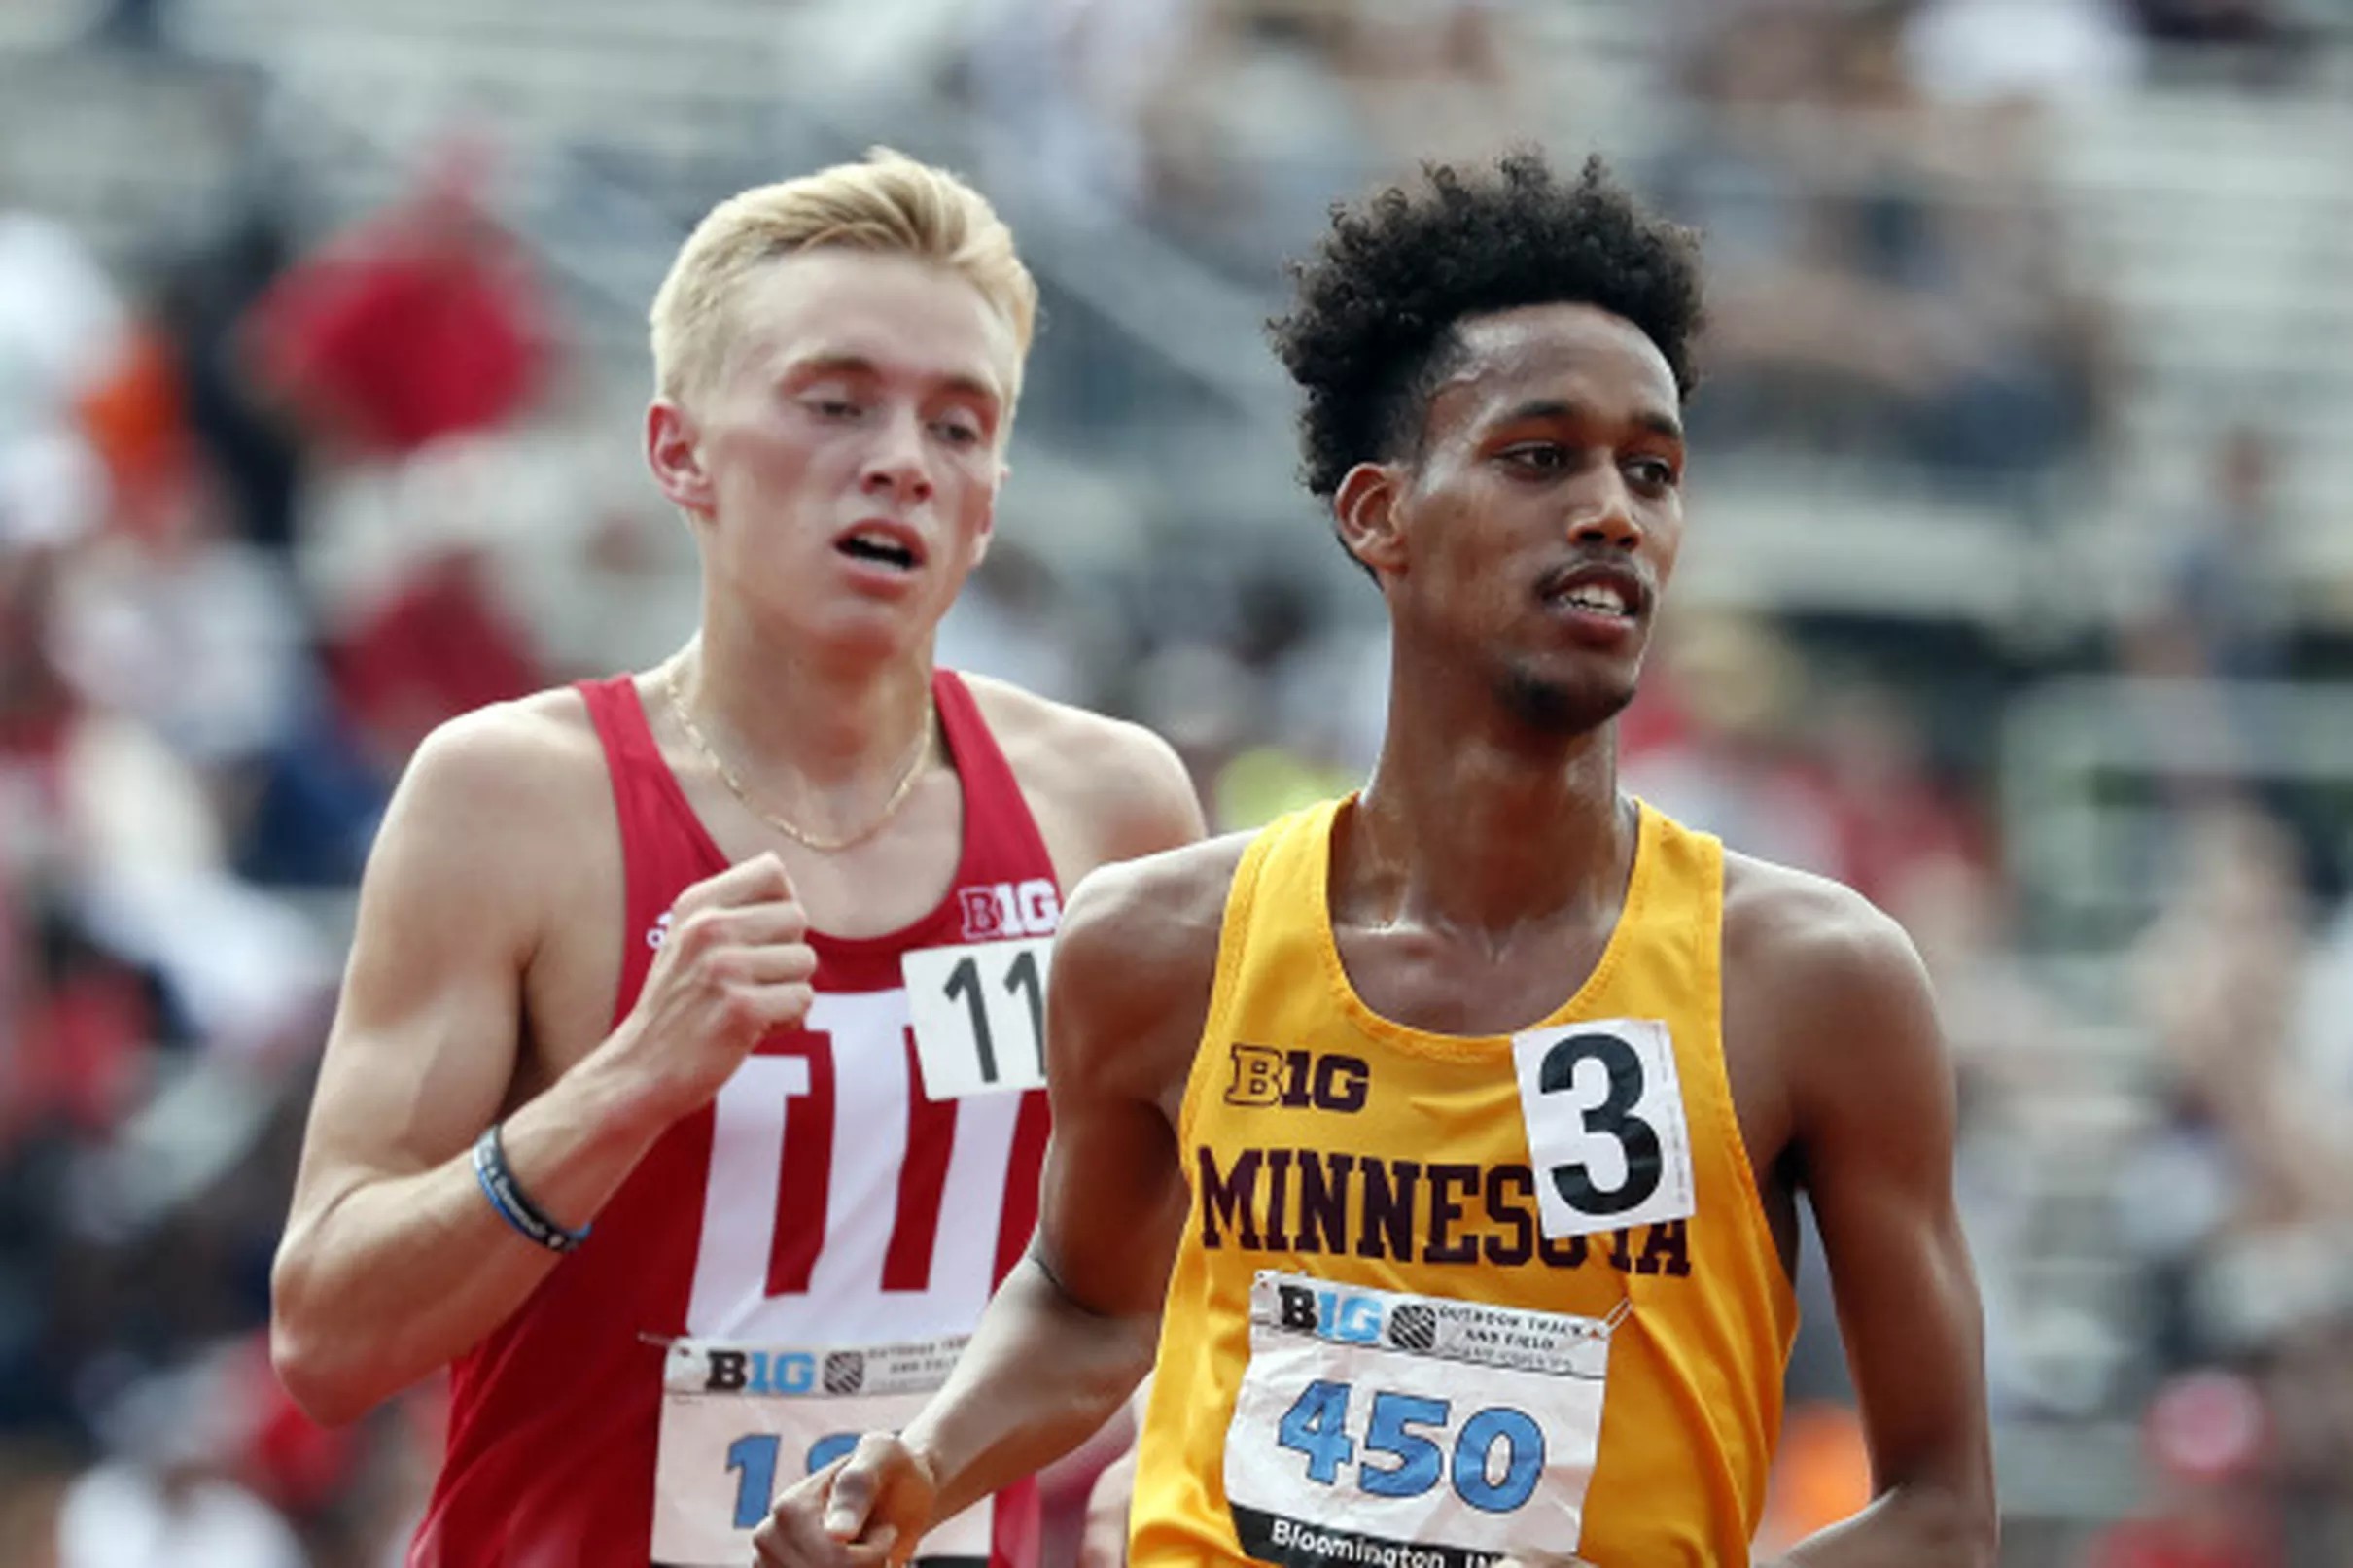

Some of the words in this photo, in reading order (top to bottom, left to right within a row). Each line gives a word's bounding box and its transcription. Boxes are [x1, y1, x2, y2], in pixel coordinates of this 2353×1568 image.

[944, 951, 1047, 1084] 11
[1540, 1033, 1662, 1215] 3
[1198, 1145, 1692, 1278] MINNESA
[1278, 1379, 1546, 1515] 450
